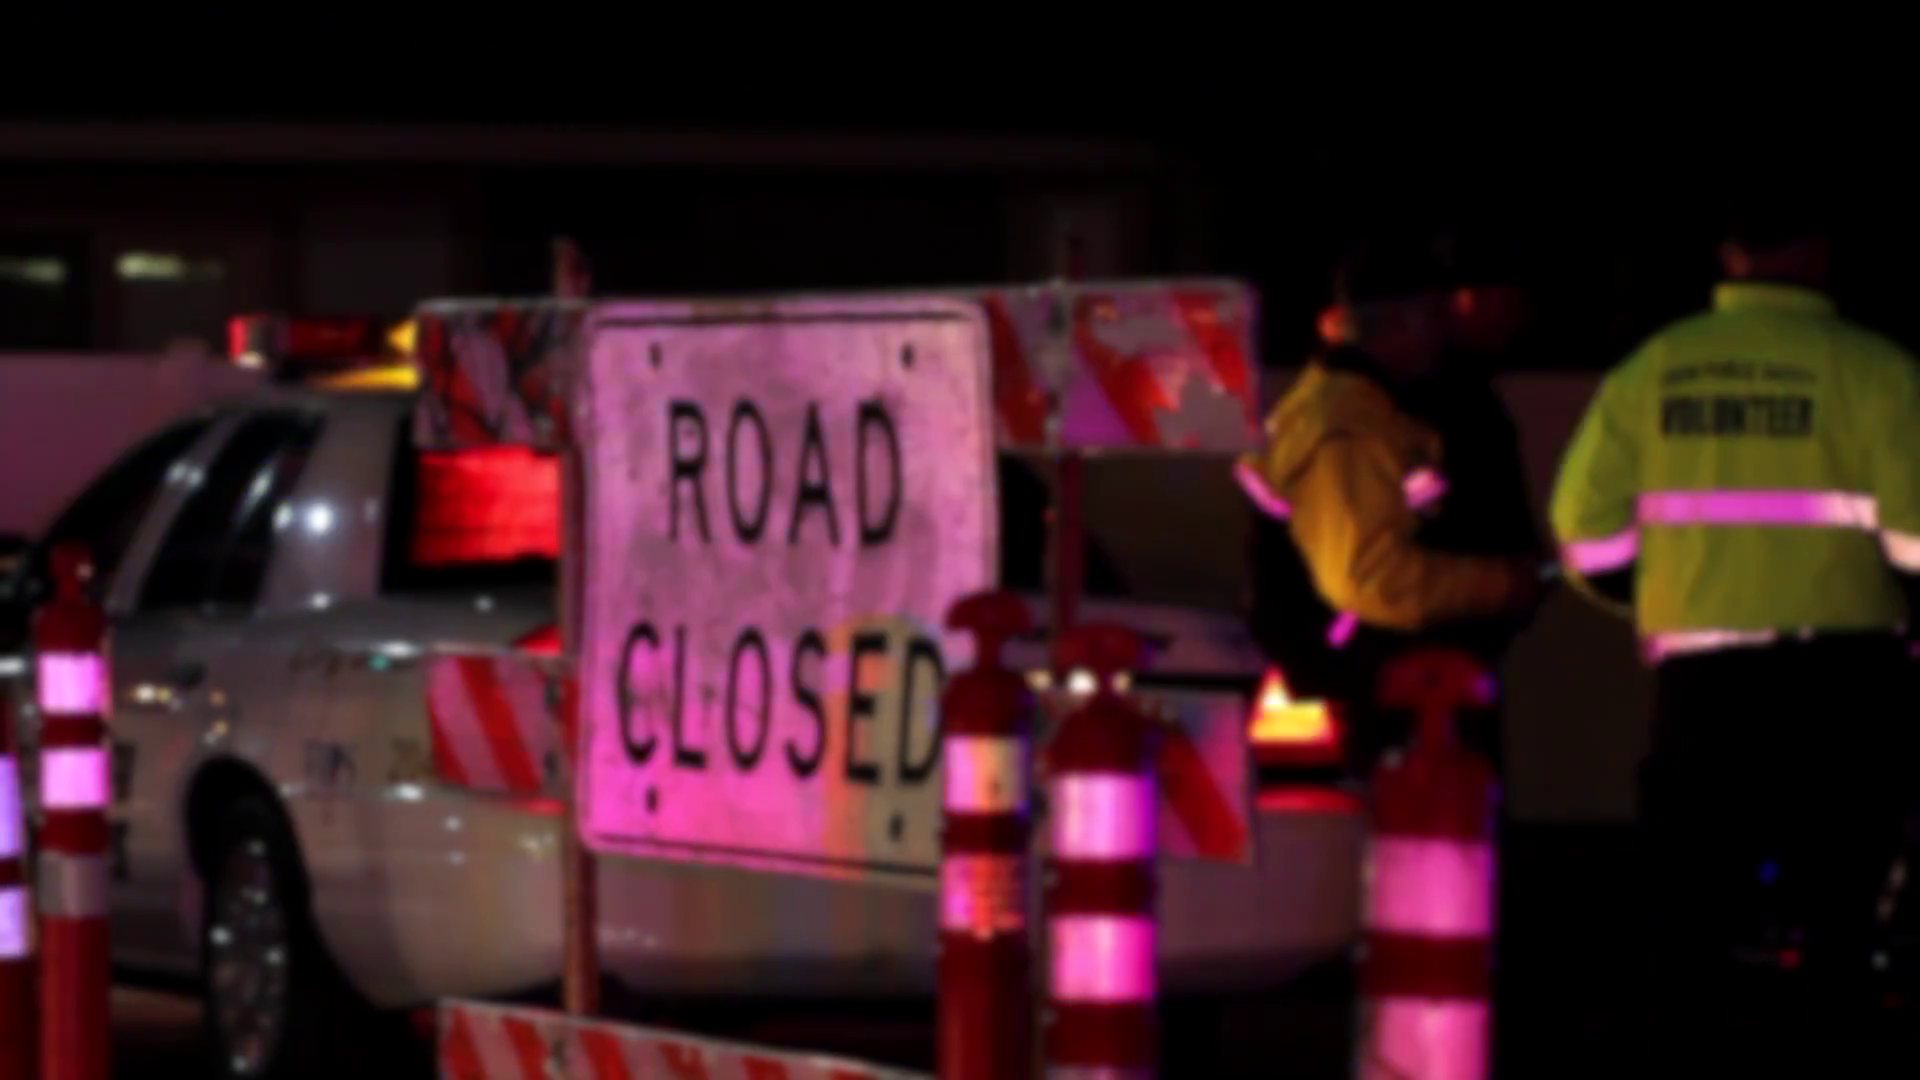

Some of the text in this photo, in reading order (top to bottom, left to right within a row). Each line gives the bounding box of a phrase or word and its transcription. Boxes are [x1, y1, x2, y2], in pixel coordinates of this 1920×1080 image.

[669, 400, 902, 546] ROAD
[1661, 395, 1814, 436] VOLUNTEER
[616, 621, 945, 784] CLOSED
